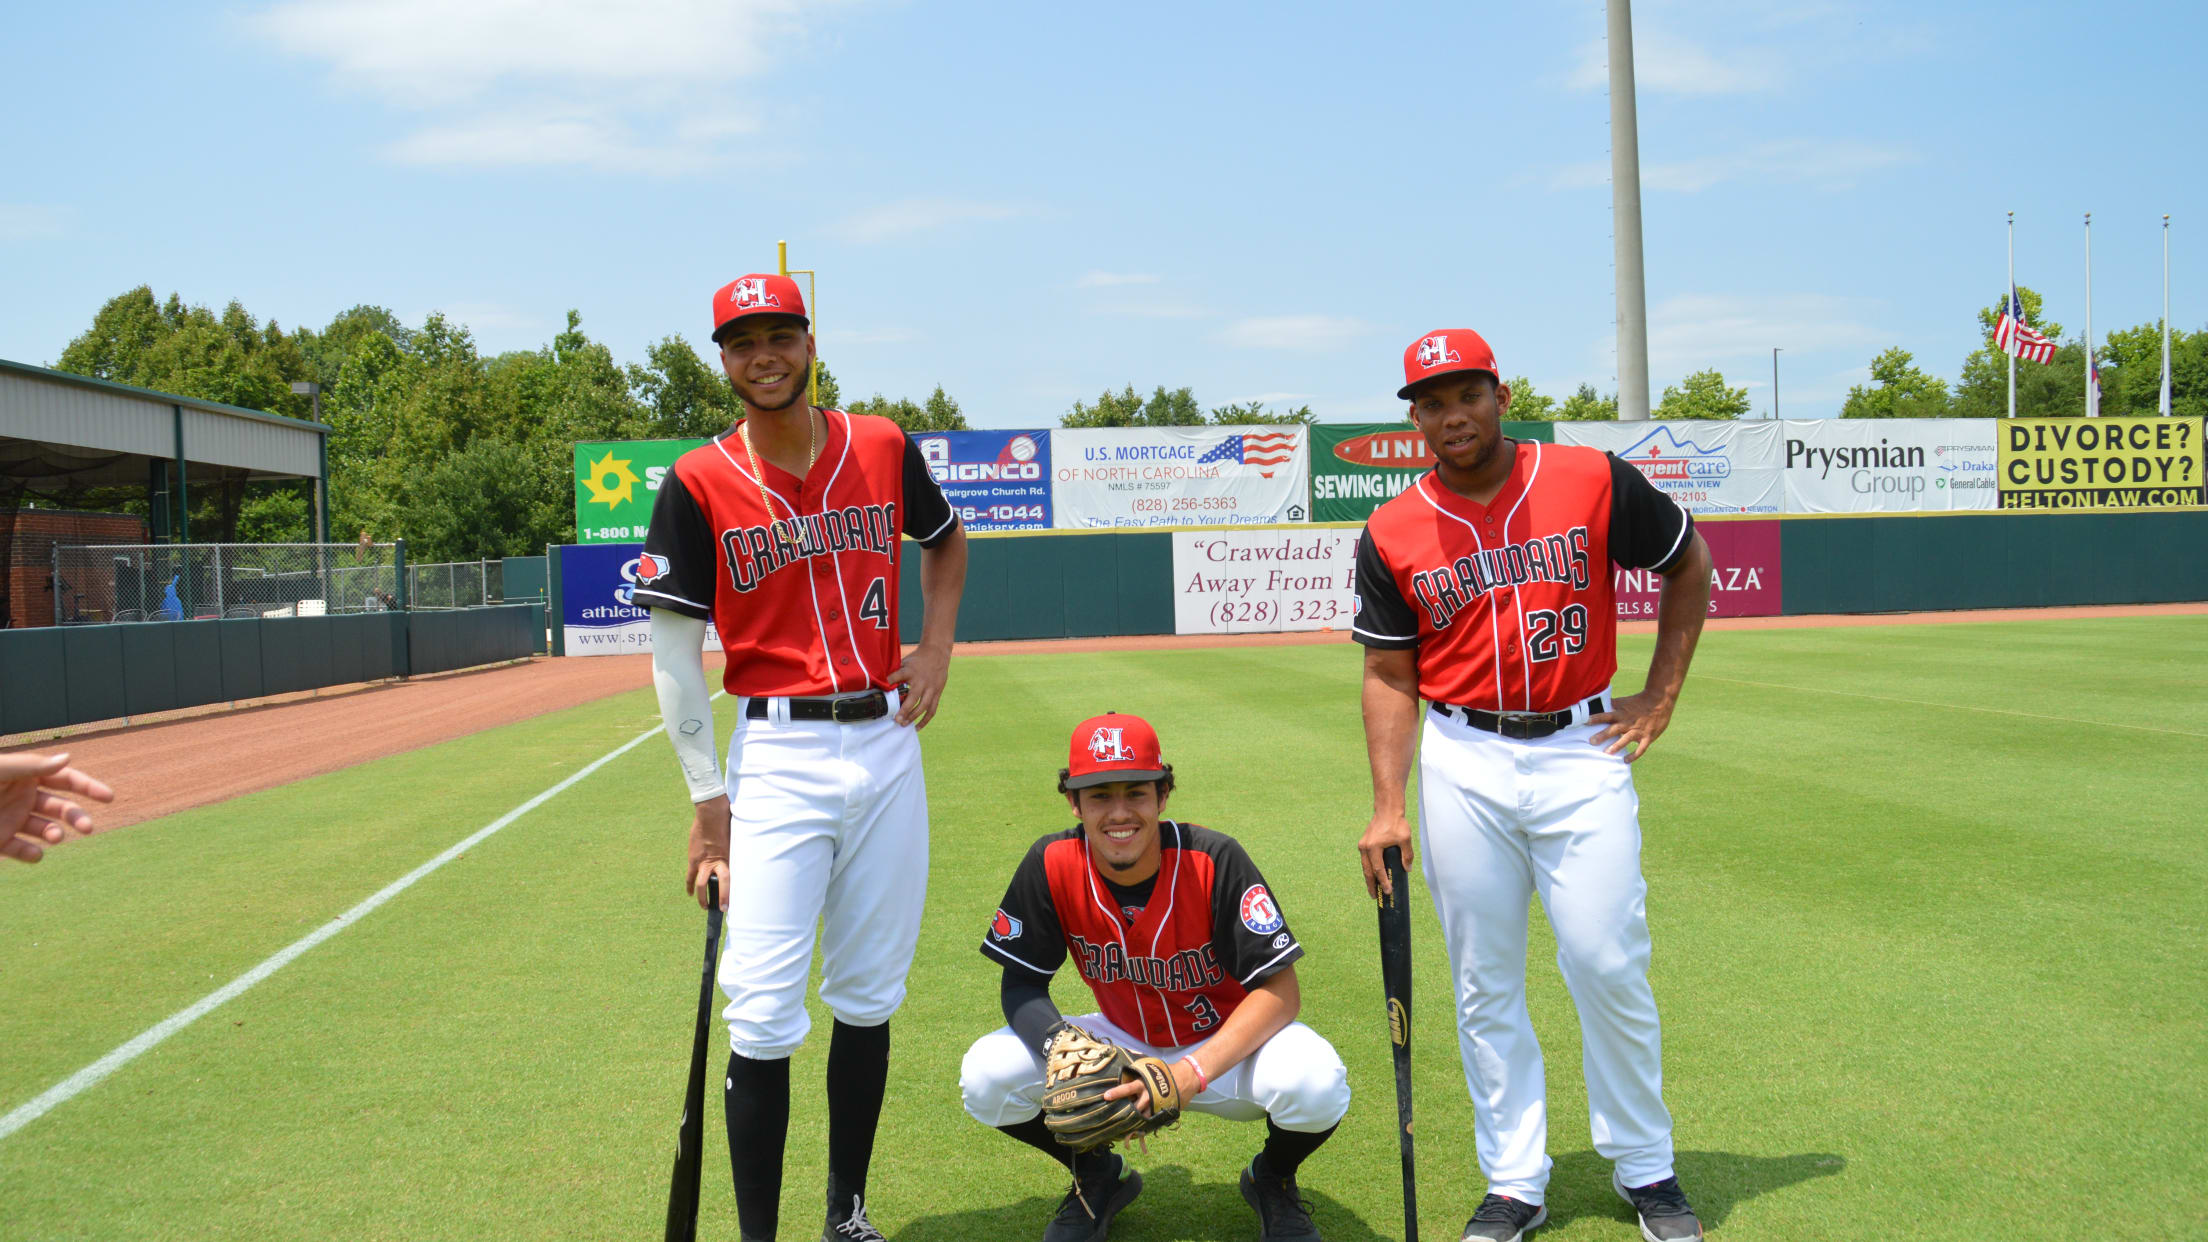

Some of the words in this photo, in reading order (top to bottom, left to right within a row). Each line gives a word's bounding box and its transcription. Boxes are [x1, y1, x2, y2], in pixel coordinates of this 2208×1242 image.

[2010, 423, 2190, 451] DIVORCE?
[1084, 447, 1111, 461] U.S.
[1115, 445, 1195, 460] MORTGAGE
[1370, 439, 1437, 459] UNI
[1786, 438, 1925, 480] Prysmian
[1962, 460, 1994, 471] Draka
[1058, 468, 1079, 482] OF
[1084, 467, 1138, 481] NORTH
[1142, 465, 1220, 480] CAROLINA
[1634, 461, 1684, 478] rgent
[1687, 461, 1726, 475] care
[2008, 455, 2193, 484] CUSTODY?
[1108, 483, 1134, 491] NMLS
[1144, 482, 1171, 491] 75597
[1314, 474, 1384, 499] SEWING
[1386, 473, 1419, 498] MA
[1655, 481, 1693, 489] UNTAIN
[1697, 480, 1721, 488] VIEW
[1851, 469, 1926, 501] Group
[1950, 477, 1975, 489] General
[1976, 477, 1996, 489] Cable
[943, 488, 988, 499] Fairgrove
[991, 487, 1026, 496] Church
[1029, 487, 1046, 496] Rd.
[1668, 491, 1707, 502] 0-2103
[2003, 489, 2198, 508] HELTONLAW.COM
[1131, 498, 1168, 514] (828)
[1172, 497, 1237, 511] 256-5363
[1692, 506, 1739, 514] MORGANTON
[1747, 505, 1778, 513] NEWTON
[1088, 517, 1111, 527] The
[1114, 516, 1146, 527] Easy
[1150, 515, 1178, 526] Path
[1182, 515, 1194, 525] to
[1198, 514, 1227, 525] Your
[1229, 514, 1277, 525] Dreams
[583, 527, 630, 539] 1-800
[1185, 572, 1256, 598] Away
[1266, 569, 1333, 591] From
[1412, 526, 1590, 631] CRAWDADS
[859, 577, 889, 629] 4
[1643, 601, 1654, 614] &
[1210, 600, 1279, 626] (828)
[1526, 603, 1588, 663] 29
[1069, 932, 1225, 992] CRAWDADS
[1184, 994, 1221, 1032] 3
